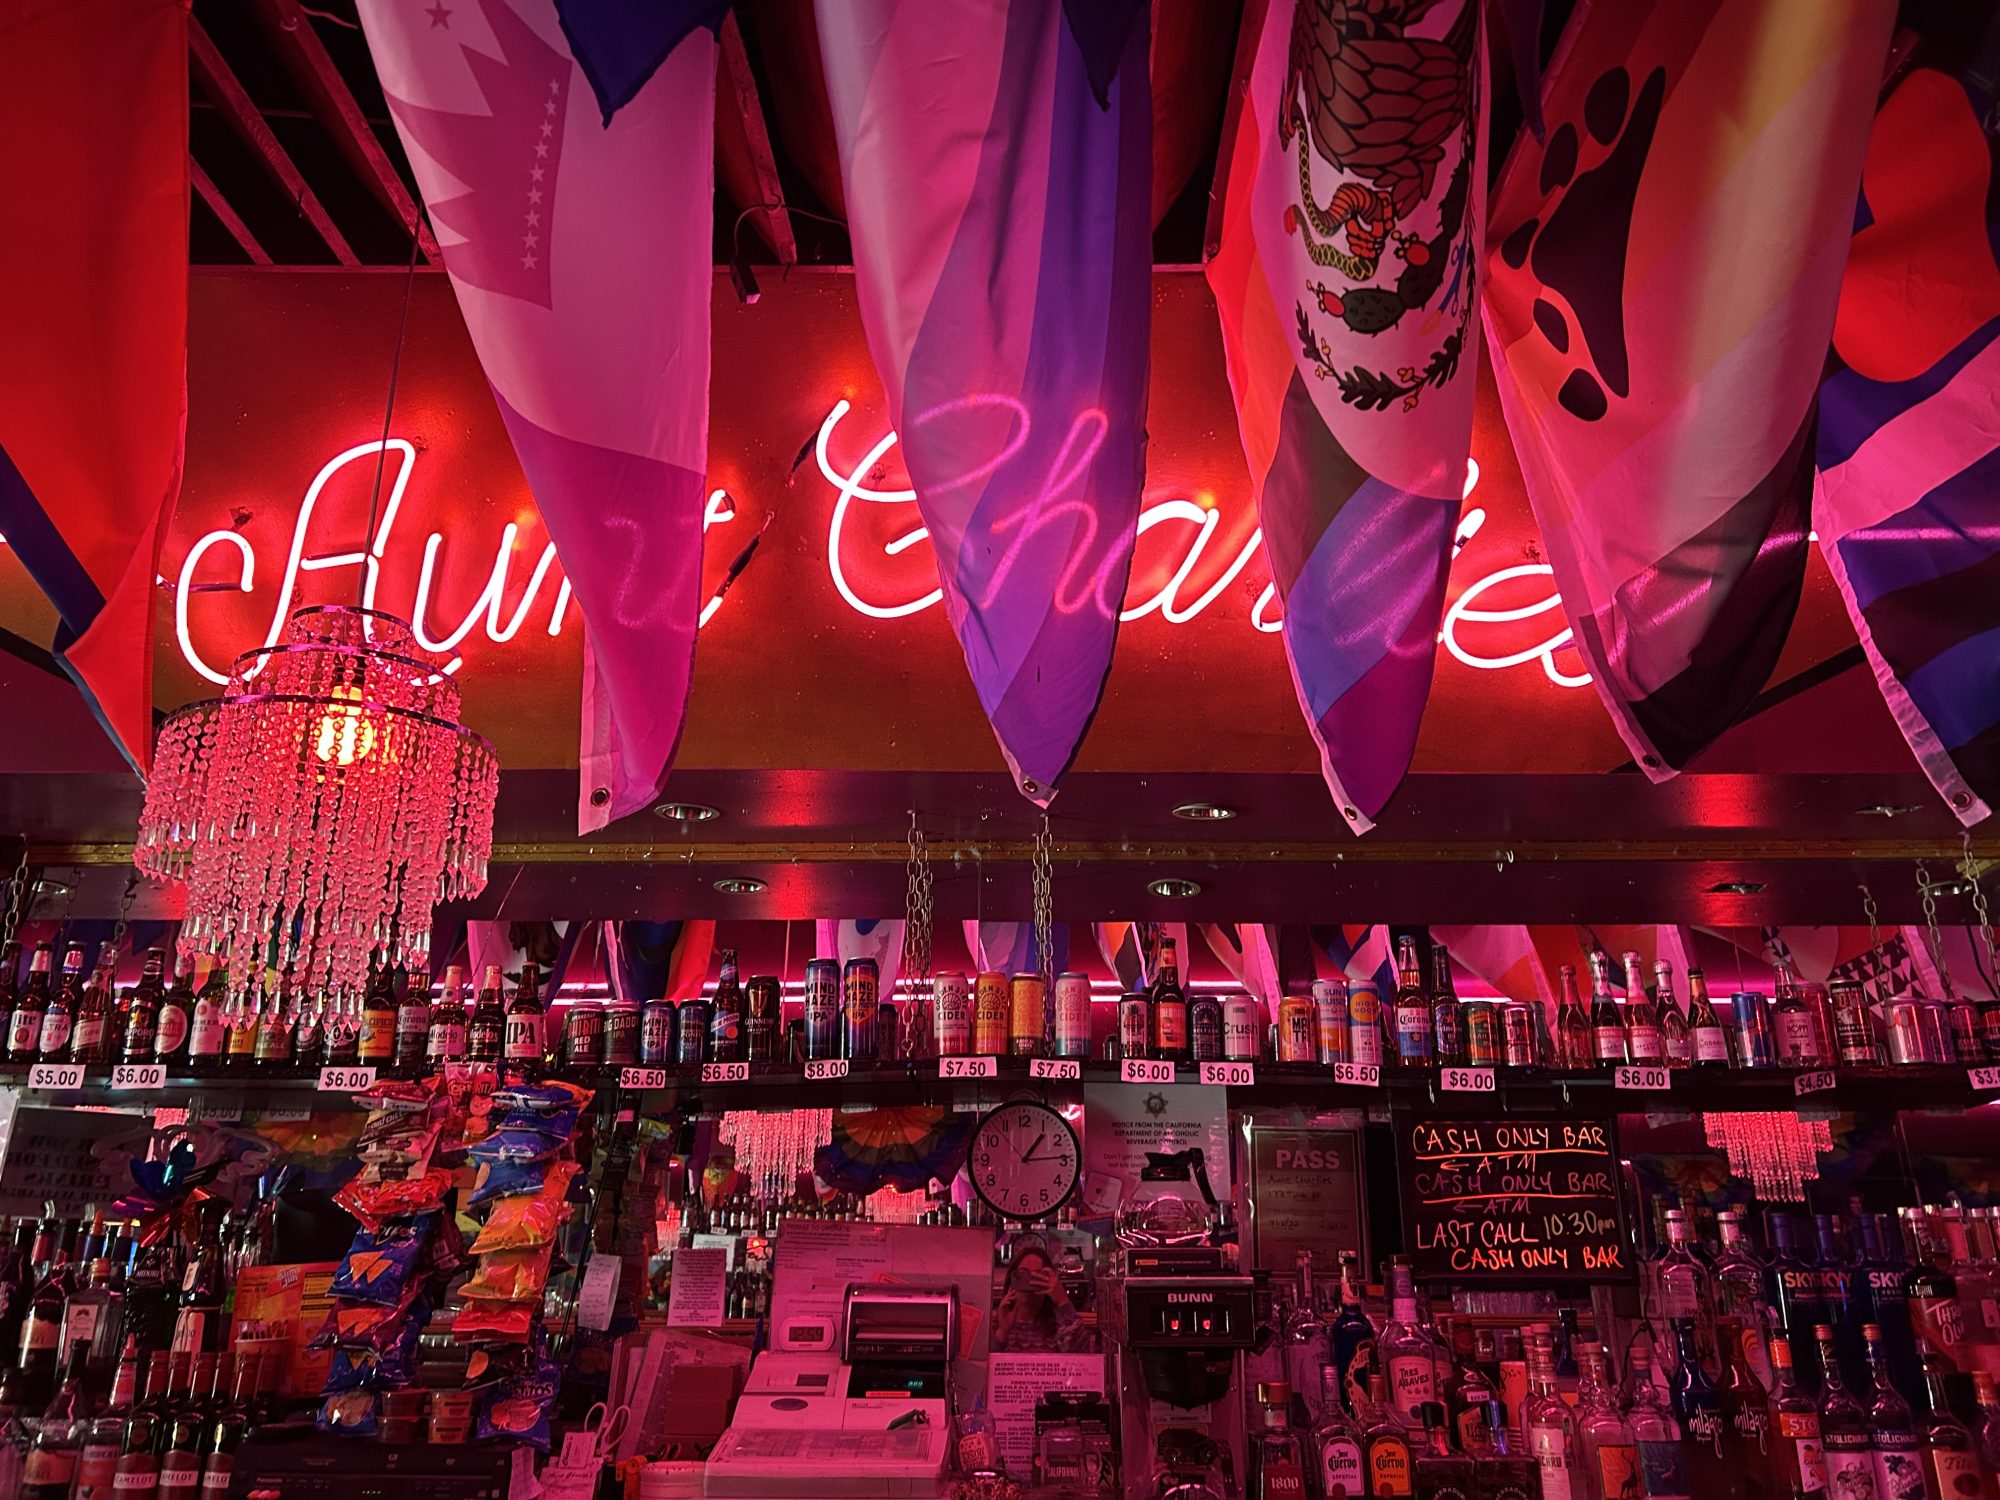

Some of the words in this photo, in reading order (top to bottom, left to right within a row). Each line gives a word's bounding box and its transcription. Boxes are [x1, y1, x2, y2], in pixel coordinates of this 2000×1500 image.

[806, 983, 835, 995] MIND
[846, 981, 873, 990] MIND
[806, 995, 835, 1006] HAZE
[845, 991, 873, 1001] HAZE
[810, 1011, 827, 1022] IPA
[938, 1012, 965, 1021] CIDER
[976, 1012, 1004, 1021] CIDER
[506, 1022, 536, 1045] IPA
[643, 1027, 668, 1037] HAZE
[1224, 1022, 1258, 1036] Crush
[574, 1045, 589, 1053] ALE
[645, 1040, 661, 1049] IPA
[702, 1064, 746, 1081] $6.50
[807, 1062, 848, 1078] $8.00
[946, 1061, 986, 1077] $7.50
[1036, 1061, 1077, 1079] $7.50
[1127, 1061, 1170, 1080] $6.00
[1206, 1066, 1249, 1084] $6.00
[1335, 1064, 1378, 1082] $6.50
[36, 1069, 78, 1086] $5.00
[116, 1068, 160, 1085] $6.00
[324, 1071, 369, 1088] $6.00
[622, 1069, 664, 1086] $6.50
[1449, 1071, 1494, 1090] $6.00
[1621, 1068, 1665, 1087] $6.00
[1797, 1072, 1833, 1093] $4.50
[1002, 1120, 1009, 1132] 11
[1019, 1115, 1031, 1128] 12
[1041, 1120, 1045, 1132] 1
[986, 1135, 999, 1147] 10
[1053, 1134, 1062, 1147] 2
[1413, 1125, 1482, 1154] CASH
[1497, 1127, 1549, 1149] ONLY
[1563, 1126, 1607, 1147] BAR
[981, 1154, 990, 1166] 9
[1059, 1154, 1068, 1167] 3
[1275, 1150, 1341, 1169] PASS
[1476, 1151, 1537, 1174] ATM
[987, 1174, 996, 1187] 8
[1053, 1174, 1062, 1187] 4
[1415, 1173, 1482, 1194] CASH
[1502, 1171, 1553, 1195] ONLY
[1567, 1173, 1612, 1192] BAR
[1001, 1189, 1010, 1201] 7
[1021, 1194, 1029, 1207] 6
[1040, 1189, 1049, 1201] 5
[1483, 1196, 1531, 1216] ATM
[1417, 1219, 1475, 1249] LAST
[1481, 1220, 1539, 1248] CALL
[1451, 1247, 1514, 1270] CASH
[1521, 1247, 1568, 1269] ONLY
[1583, 1244, 1624, 1269] BAR
[1168, 1293, 1214, 1303] BUNN
[1399, 1367, 1419, 1378] TRES
[1398, 1375, 1430, 1391] AGAVES
[1688, 1402, 1724, 1459] milagro
[1789, 1418, 1818, 1431] STO
[1328, 1456, 1358, 1471] Cuervo
[1375, 1456, 1405, 1471] Cuervo
[160, 1473, 193, 1482] AMELOT
[1271, 1476, 1299, 1489] 1800
